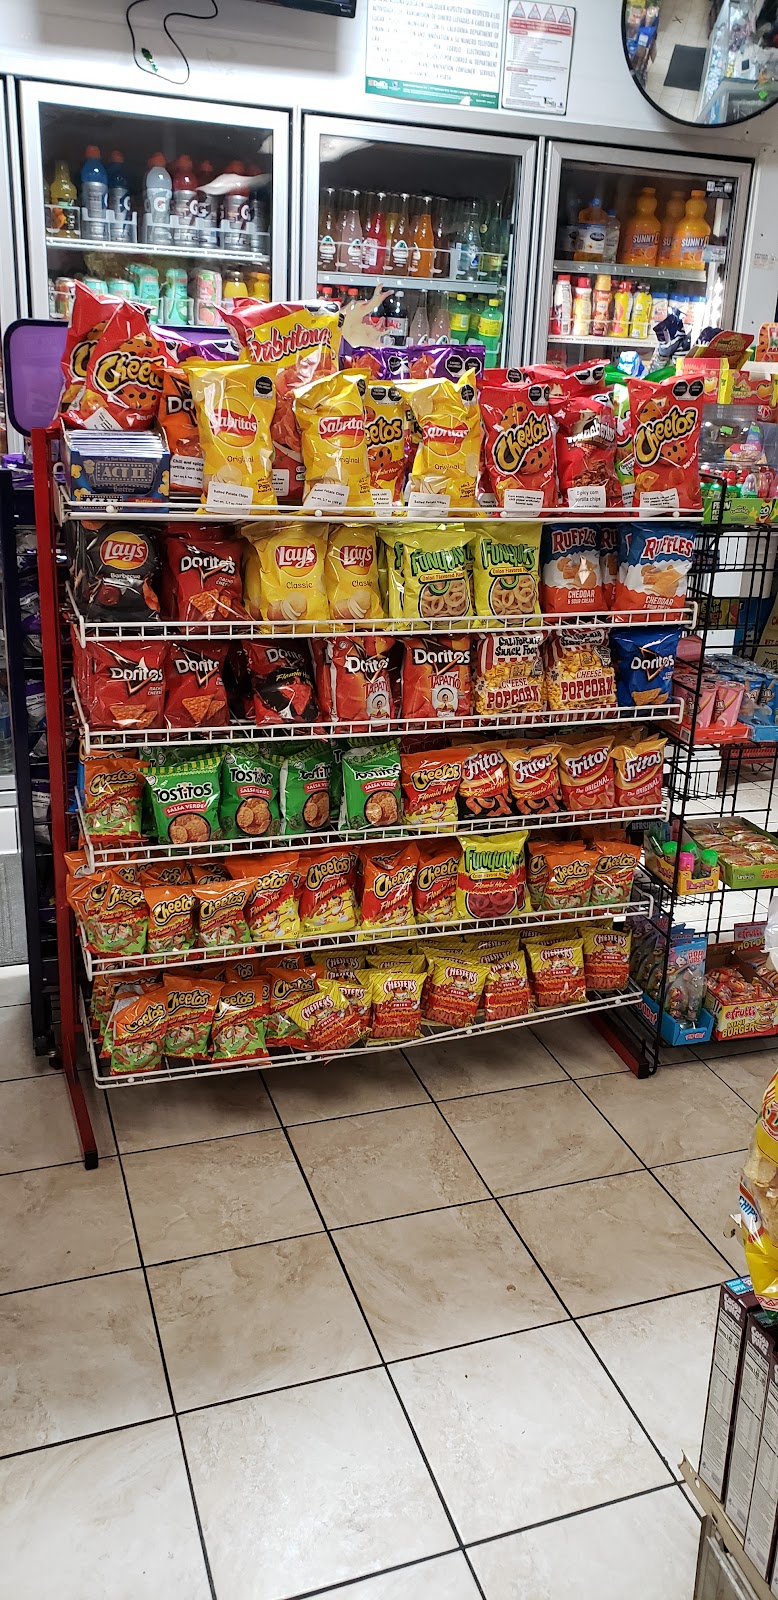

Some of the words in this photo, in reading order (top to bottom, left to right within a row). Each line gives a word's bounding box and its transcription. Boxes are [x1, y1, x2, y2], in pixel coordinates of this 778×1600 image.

[318, 417, 364, 434] Sabrita
[365, 418, 403, 447] eetos
[636, 406, 697, 465] Cheetos
[493, 411, 550, 473] Cheetos
[227, 455, 254, 463] Original
[102, 467, 128, 478] ACT
[133, 468, 147, 478] II
[552, 527, 596, 552] RUFFLES
[642, 536, 694, 560] RUFFLES
[104, 541, 146, 562] Lay's
[277, 544, 316, 568] Lay's
[344, 544, 373, 567] Lay's
[180, 555, 236, 575] Doritos
[286, 581, 314, 589] Classic
[352, 580, 373, 588] Classic
[567, 590, 596, 599] CHEDDAR
[645, 596, 674, 605] CHEDDAR
[414, 649, 470, 665] Doritos
[631, 655, 675, 670] Doritos
[110, 666, 163, 682] Doritos
[501, 677, 528, 688] CHEESE
[576, 669, 602, 679] CHEESE
[487, 685, 539, 709] POPCORN
[561, 676, 614, 700] POPCORN
[464, 750, 504, 781] Fritos
[513, 753, 552, 782] Fritos
[565, 747, 610, 777] Fritos
[625, 750, 661, 781] Fritos
[90, 770, 137, 796] Cheetos
[365, 782, 380, 790] SALSA
[412, 764, 461, 791] Cheetos
[585, 775, 610, 793] ORIGINAL
[636, 779, 660, 795] ORIGINAL
[166, 805, 184, 814] SALSA
[185, 802, 205, 811] VERDE
[306, 856, 350, 891] Cheetos
[417, 857, 458, 891] Cheeto
[553, 860, 589, 885] Cheetos
[595, 853, 637, 874] Cheetos
[374, 865, 417, 899] Cheetos
[107, 886, 142, 909] Cheeto
[201, 892, 246, 920] Cheetos
[738, 939, 765, 950] HOT-DO
[273, 978, 314, 1000] Cheetos
[168, 990, 209, 1015] Cheetos
[722, 1024, 755, 1039] BURGER
